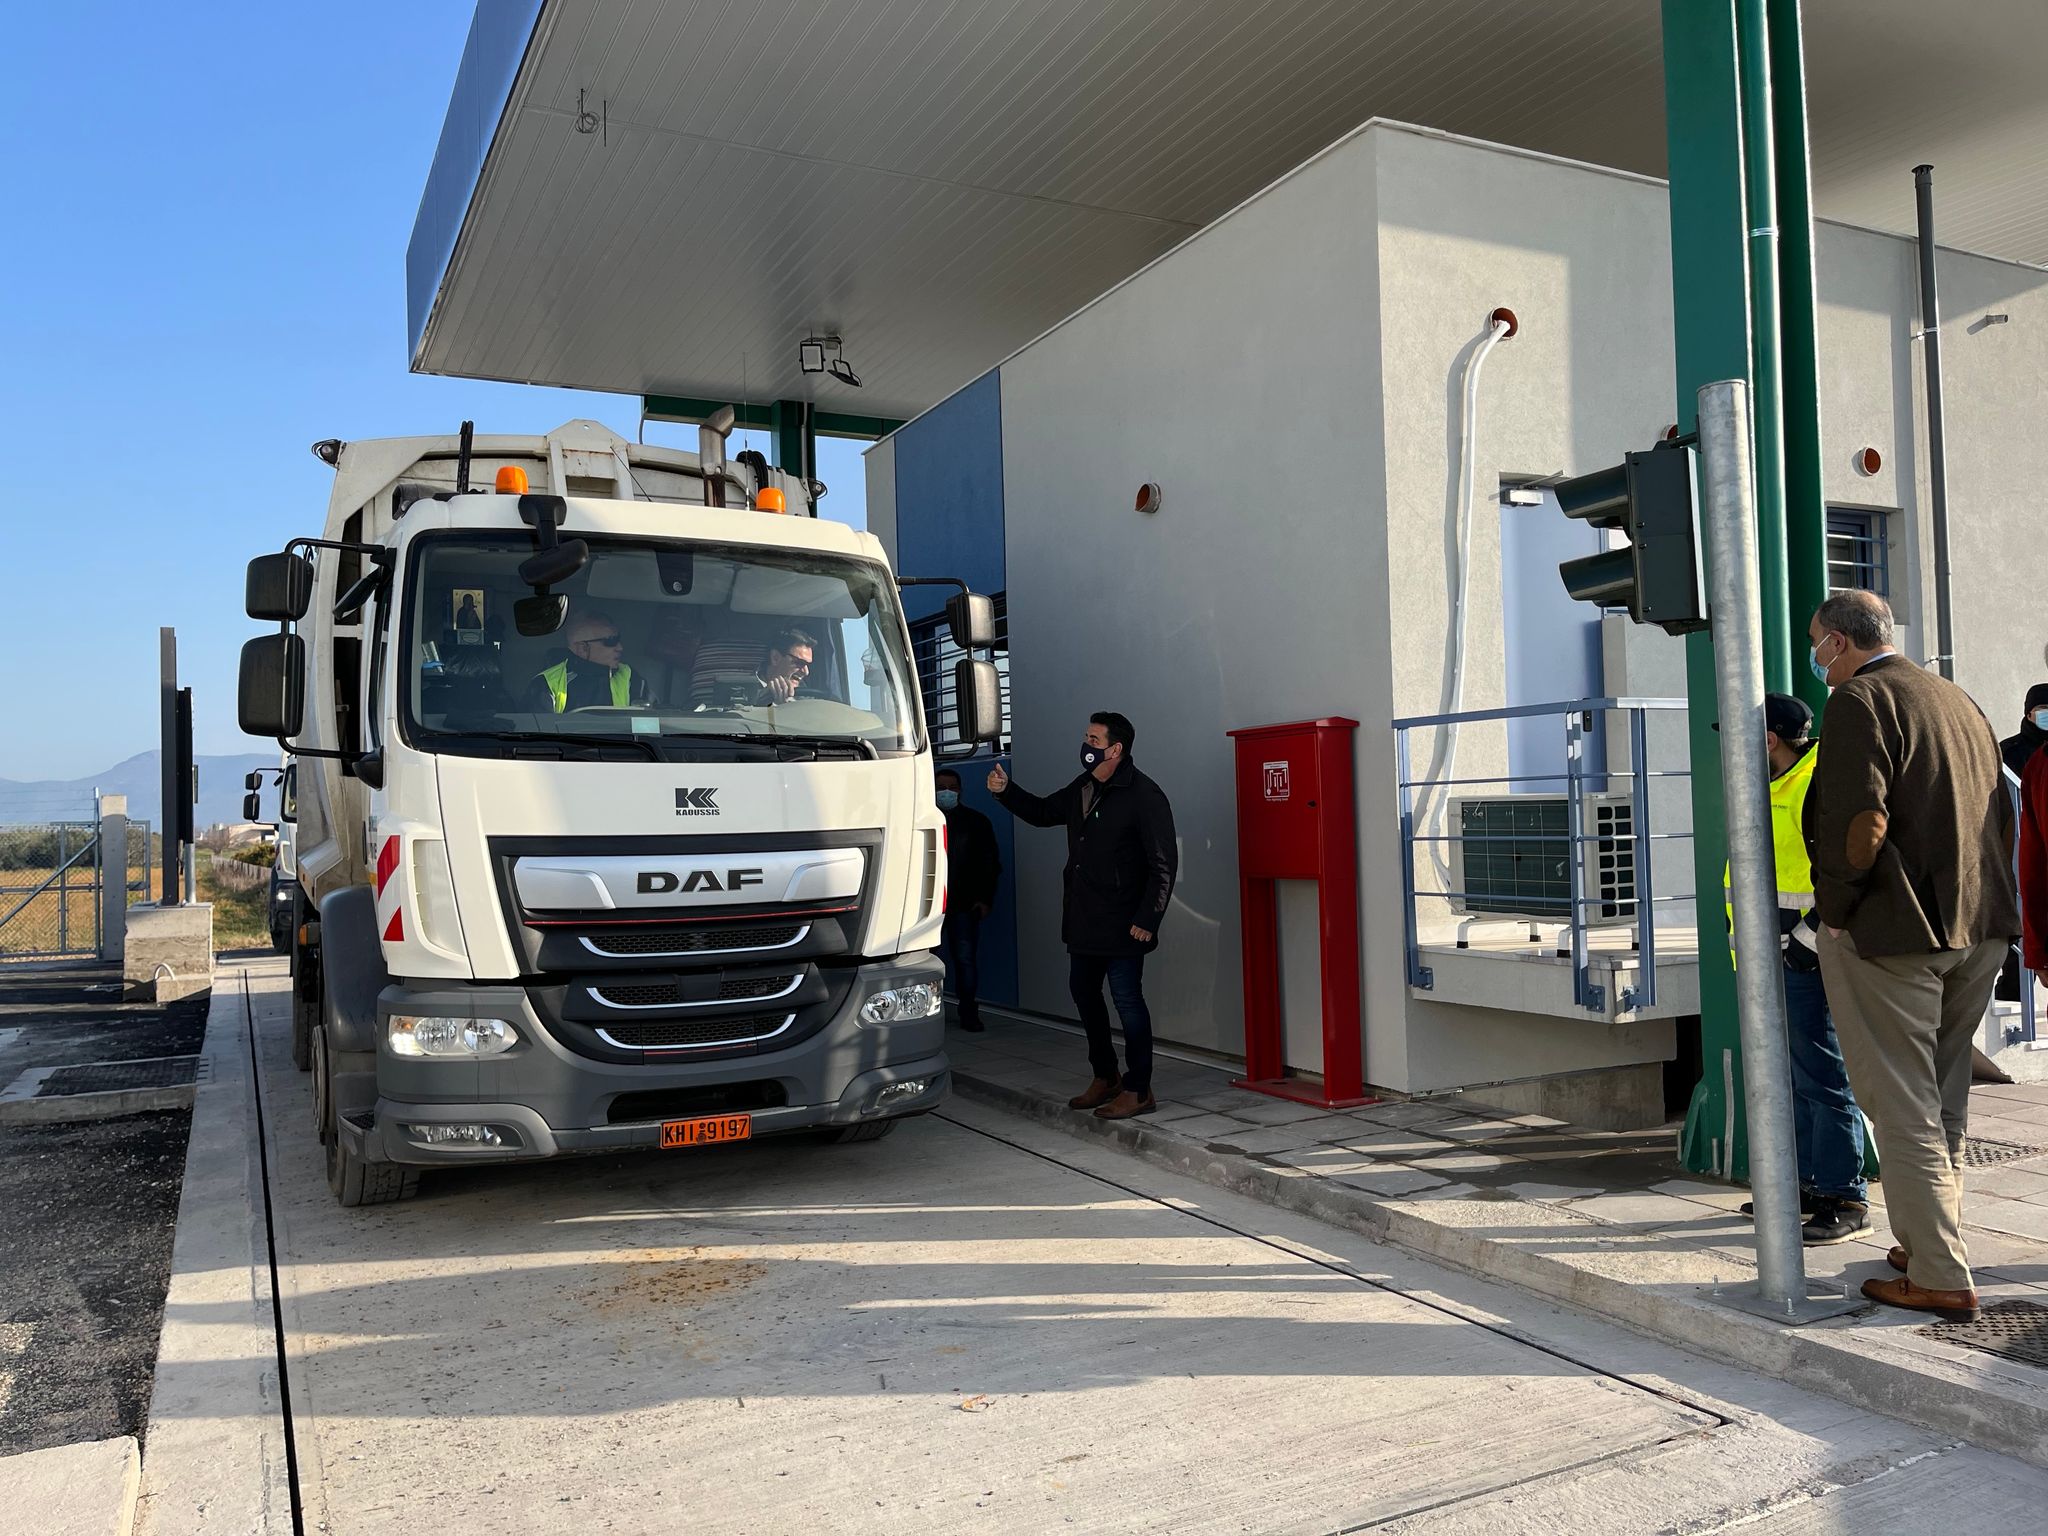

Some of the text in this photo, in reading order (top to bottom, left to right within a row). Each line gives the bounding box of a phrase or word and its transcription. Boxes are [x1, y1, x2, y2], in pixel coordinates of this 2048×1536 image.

[637, 868, 763, 894] DAF
[664, 1118, 748, 1144] KHI 9197
